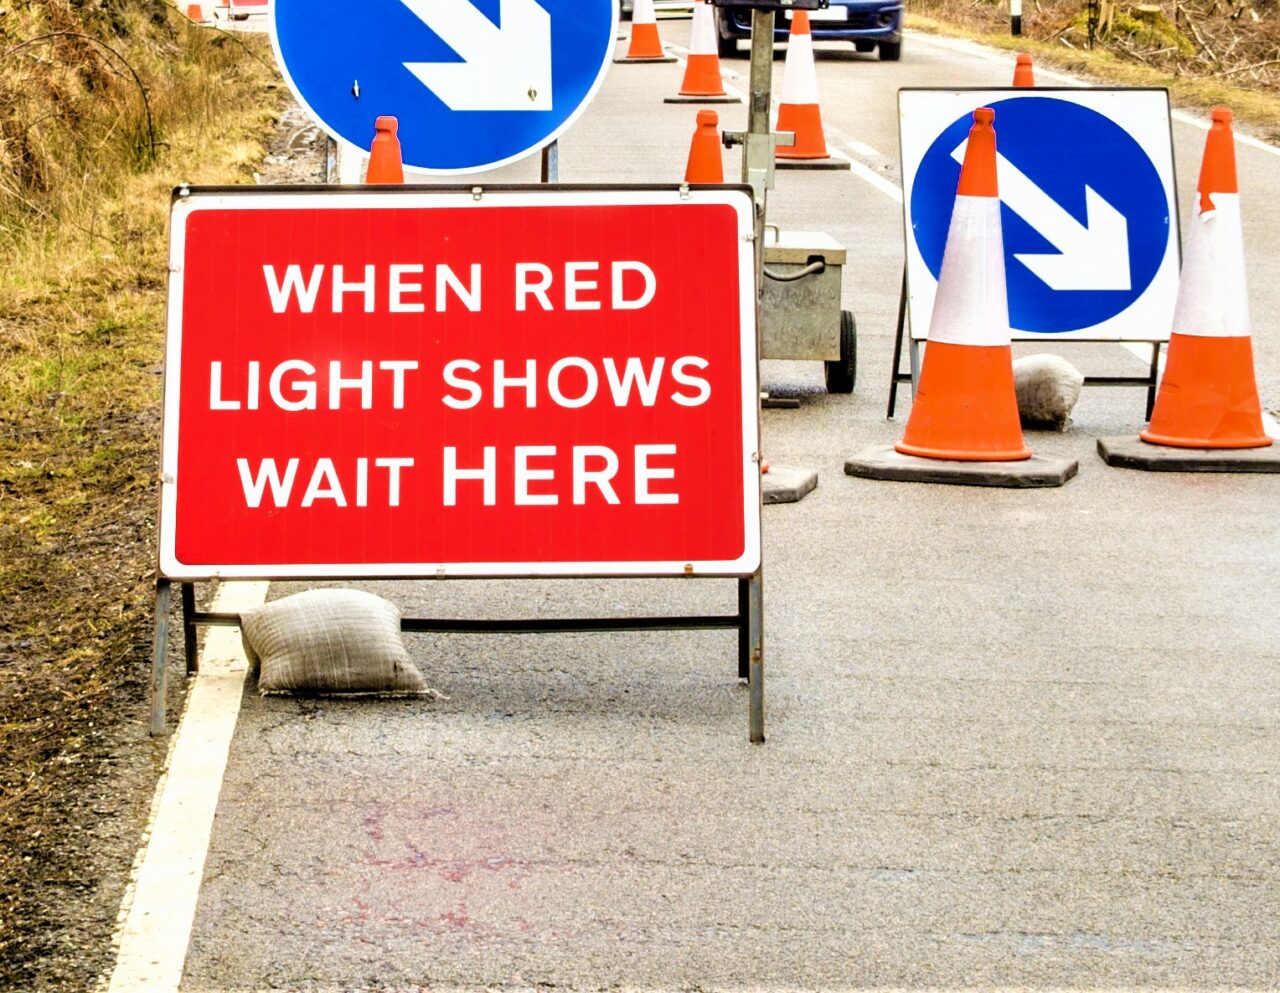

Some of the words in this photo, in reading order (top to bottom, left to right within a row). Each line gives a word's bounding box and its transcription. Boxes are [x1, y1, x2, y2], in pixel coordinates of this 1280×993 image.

[262, 263, 482, 314] WHEN
[515, 260, 657, 312] RED
[209, 359, 419, 412] LIGHT
[441, 355, 712, 410] SHOWS
[236, 457, 415, 508] WAIT
[443, 443, 680, 507] HERE
